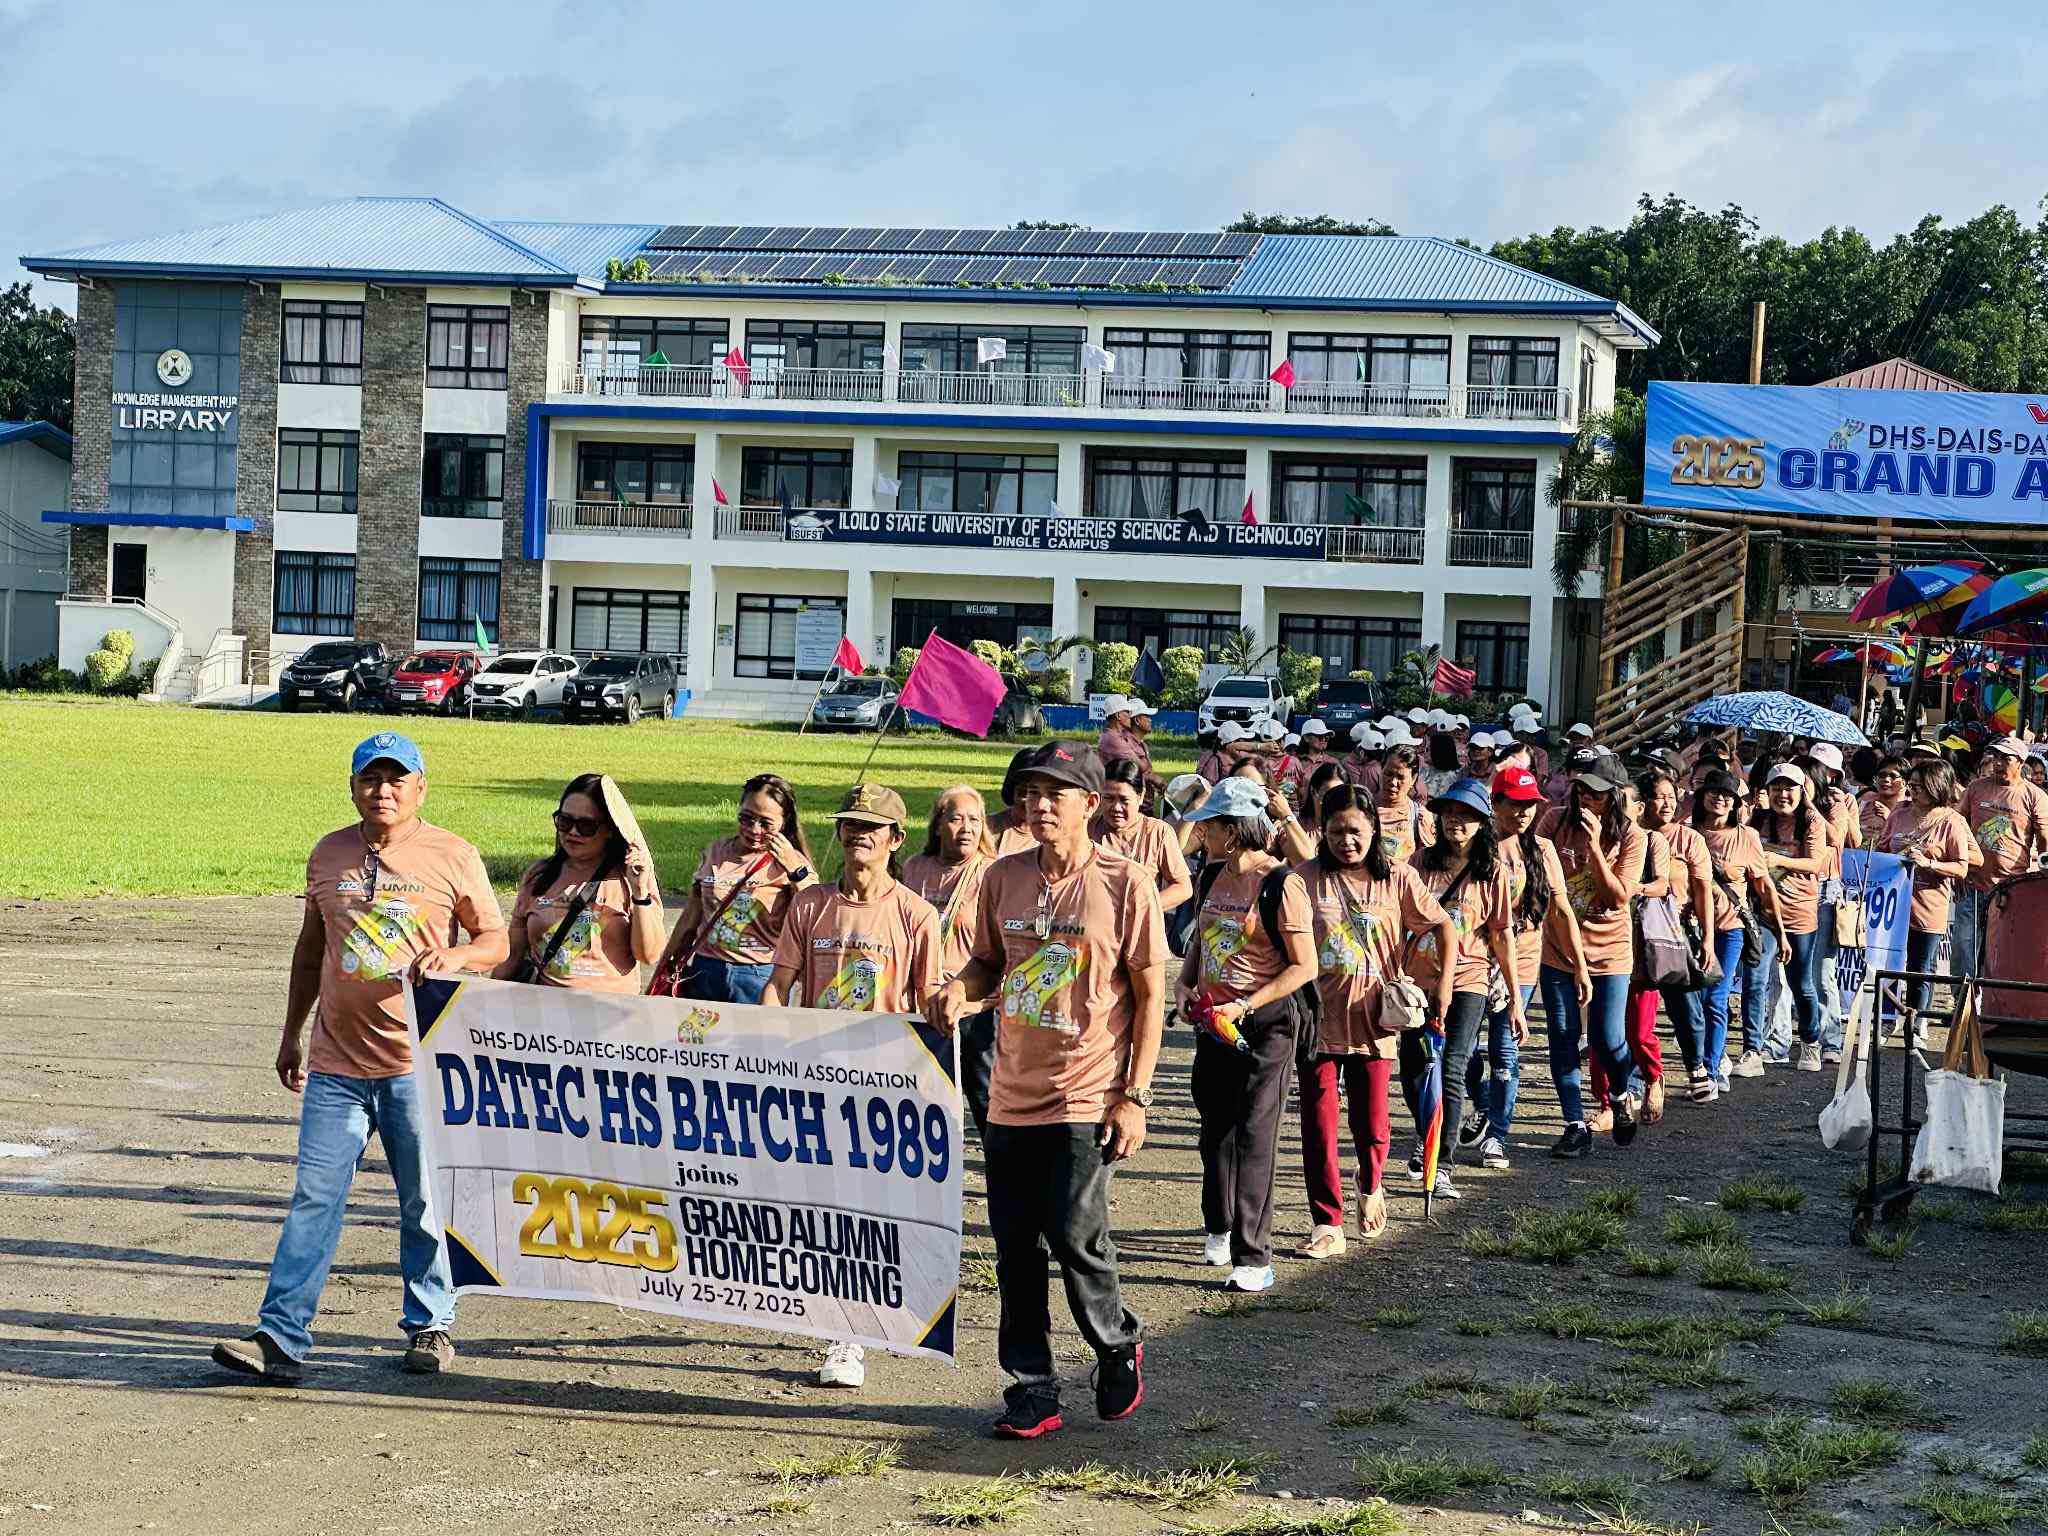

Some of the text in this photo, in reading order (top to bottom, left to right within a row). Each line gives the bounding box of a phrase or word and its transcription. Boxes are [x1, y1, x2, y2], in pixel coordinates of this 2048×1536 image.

[112, 392, 160, 406] KNOWLEDGE
[161, 394, 219, 408] MANAGEMENT
[119, 408, 232, 431] LIBRARY
[1671, 436, 1765, 489] 2025
[1777, 448, 1996, 498] GRAND
[791, 529, 824, 540] ISUFST
[838, 512, 880, 531] ILOILO
[885, 514, 926, 533] STATE
[932, 515, 1016, 536] UNIVERSITY
[1021, 518, 1040, 537] OF
[1045, 519, 1117, 539] FISHERIES
[1122, 522, 1182, 542] SCIENCE
[1225, 525, 1324, 546] TECHNOLOGY
[992, 535, 1110, 550] DINGLE CAMPUS
[965, 604, 999, 615] WELCOME
[469, 1028, 918, 1090] DHS-DAIS-DATEC-ISCOF-ISUFST ALUMNI ASSOCIATION
[434, 1052, 950, 1184] DATEC HS BATCH 1989
[675, 1161, 740, 1188] joins
[512, 1173, 679, 1273] 2025
[679, 1195, 901, 1266] GRAND ALUMNI
[685, 1235, 903, 1309] HOMECOMING
[640, 1274, 806, 1316] July 25-27, 2025
